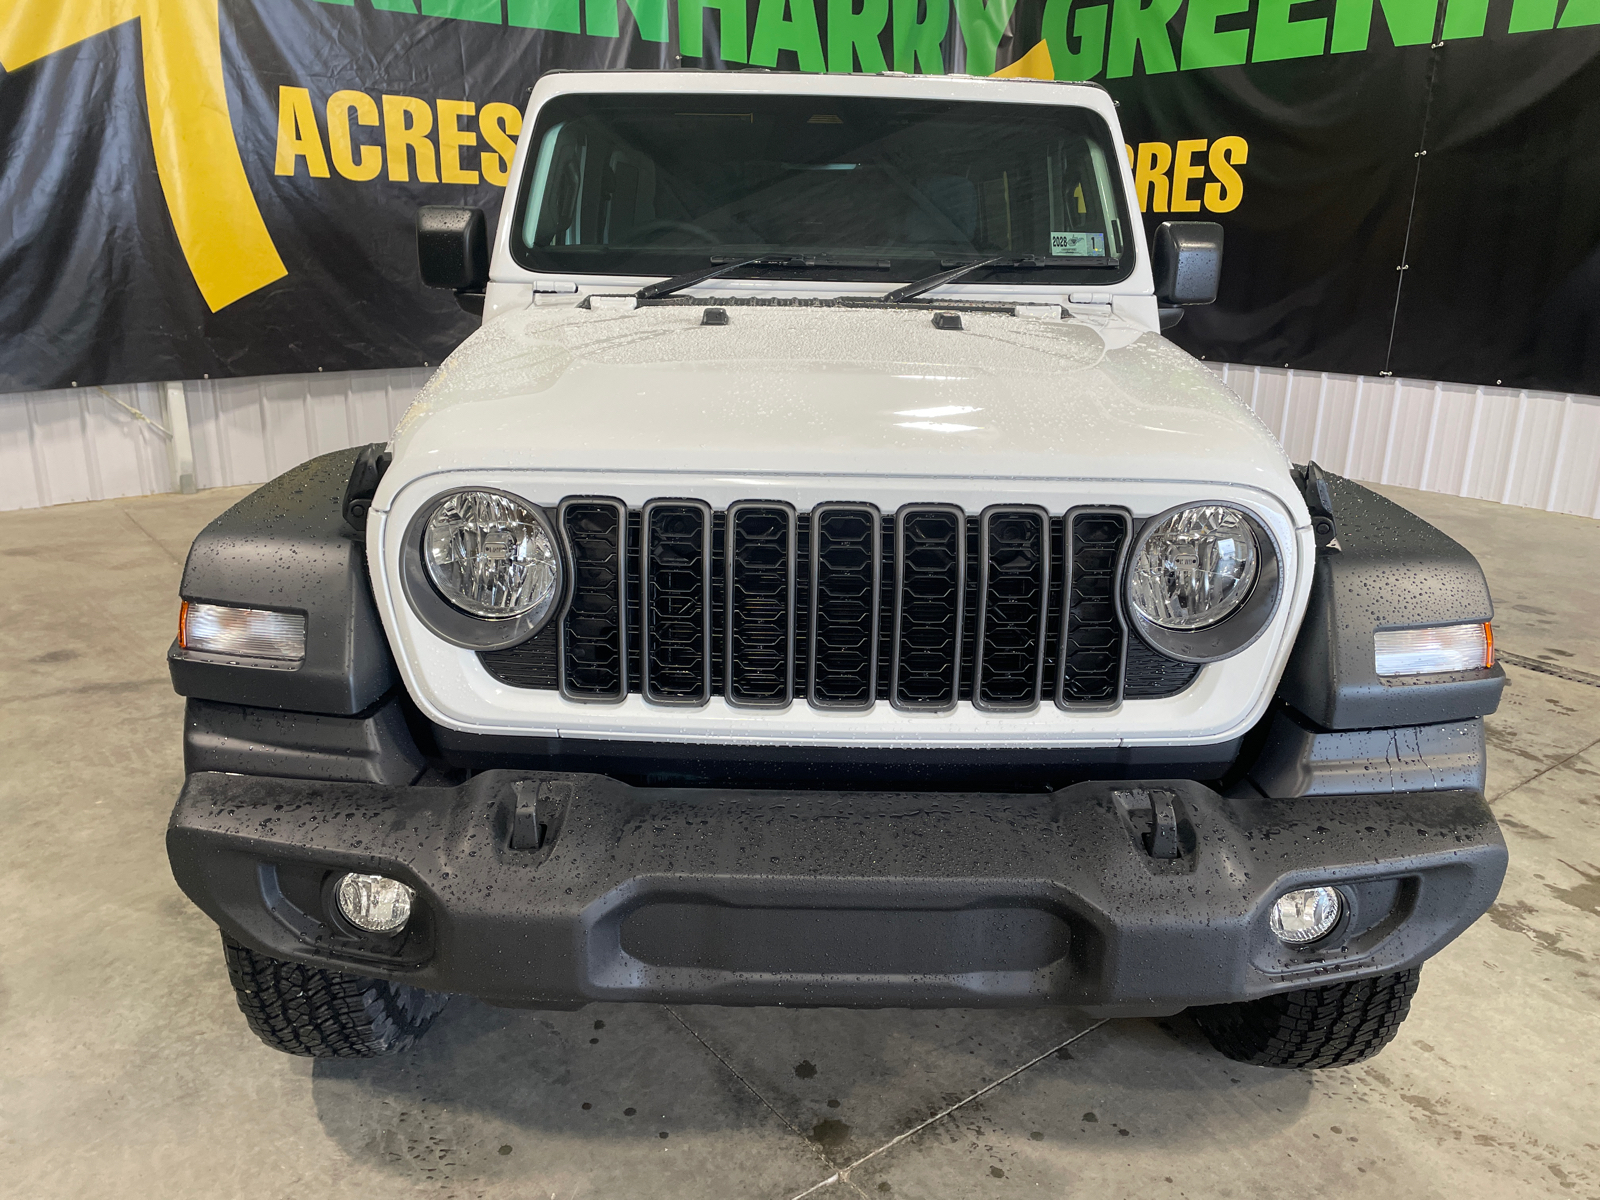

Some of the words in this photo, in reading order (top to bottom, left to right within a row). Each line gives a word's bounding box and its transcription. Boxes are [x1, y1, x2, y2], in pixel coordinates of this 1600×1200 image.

[274, 85, 523, 187] ACRES
[1124, 135, 1249, 214] RES
[1091, 236, 1095, 249] 1
